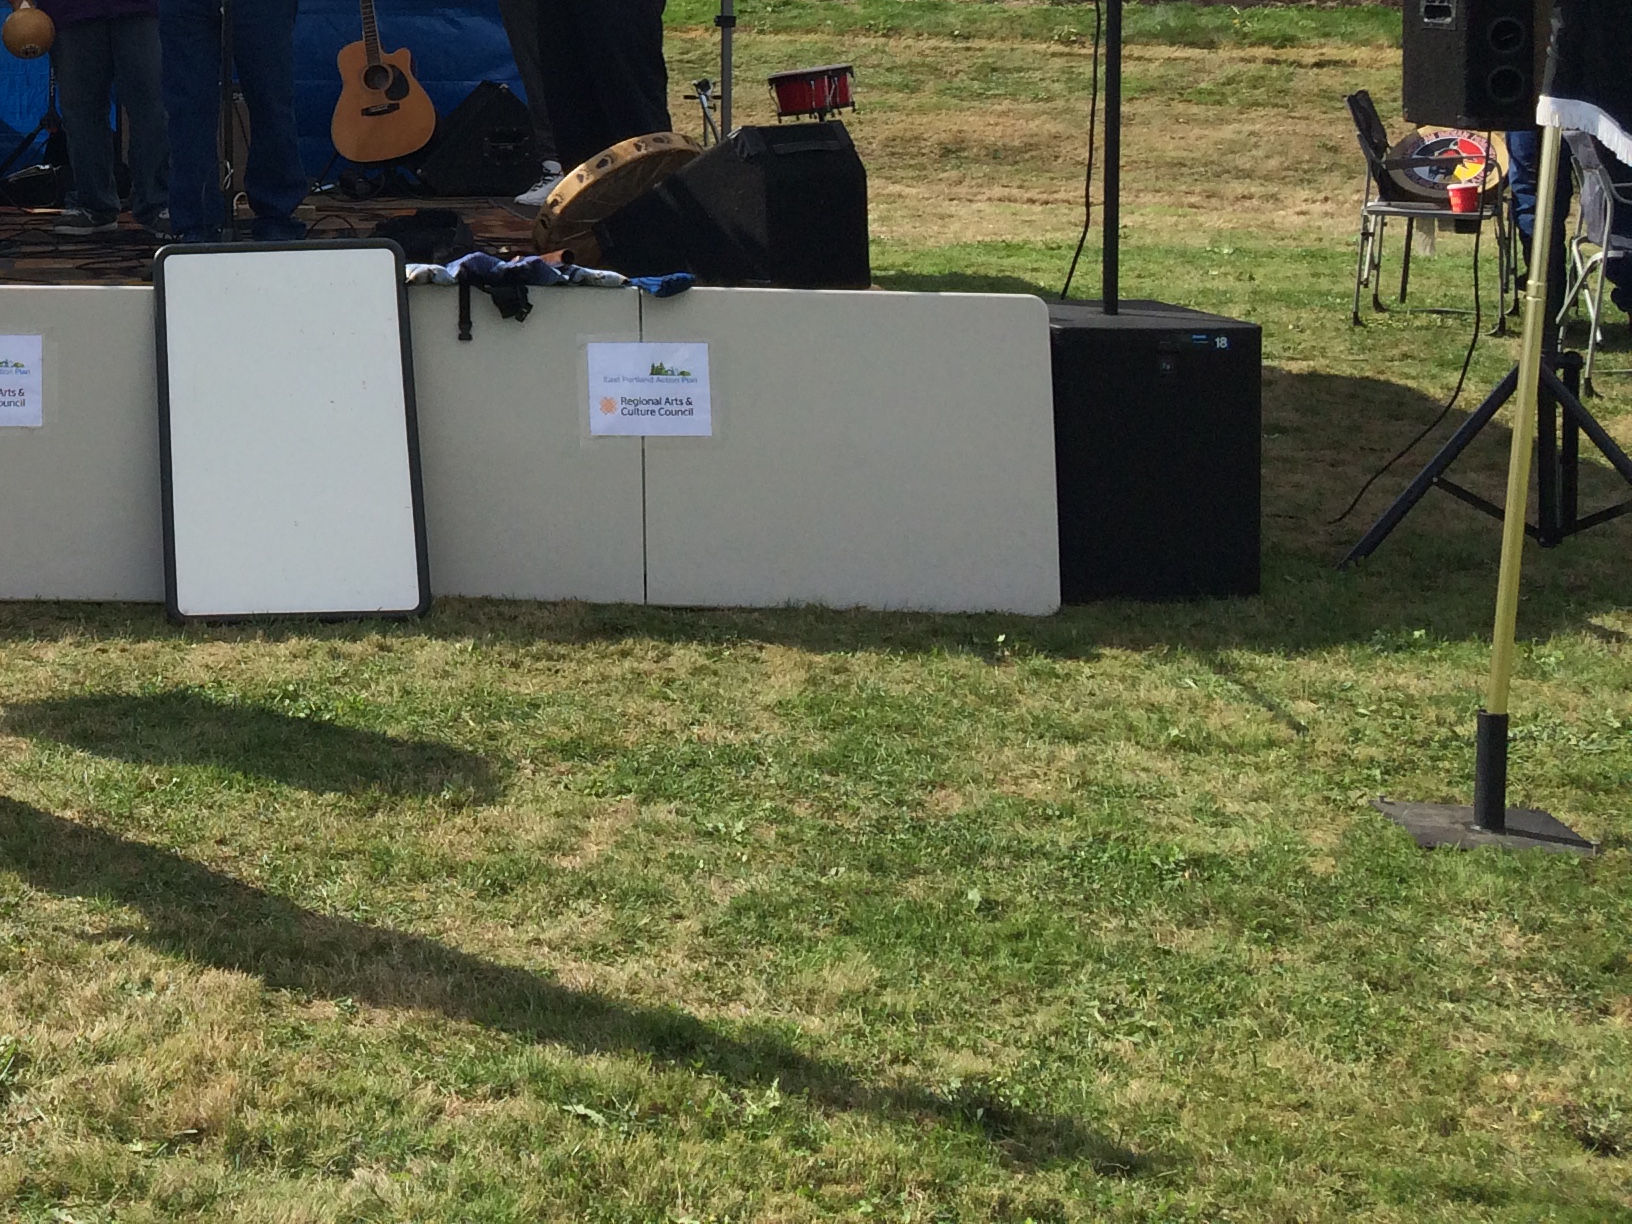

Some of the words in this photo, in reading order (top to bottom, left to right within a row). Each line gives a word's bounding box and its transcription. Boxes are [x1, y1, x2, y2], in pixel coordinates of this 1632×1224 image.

[1215, 336, 1228, 349] 18
[18, 388, 25, 397] &
[620, 397, 662, 407] Regional
[664, 397, 683, 406] Arts
[685, 397, 693, 406] &
[620, 407, 656, 416] Culture
[658, 407, 694, 416] Council
